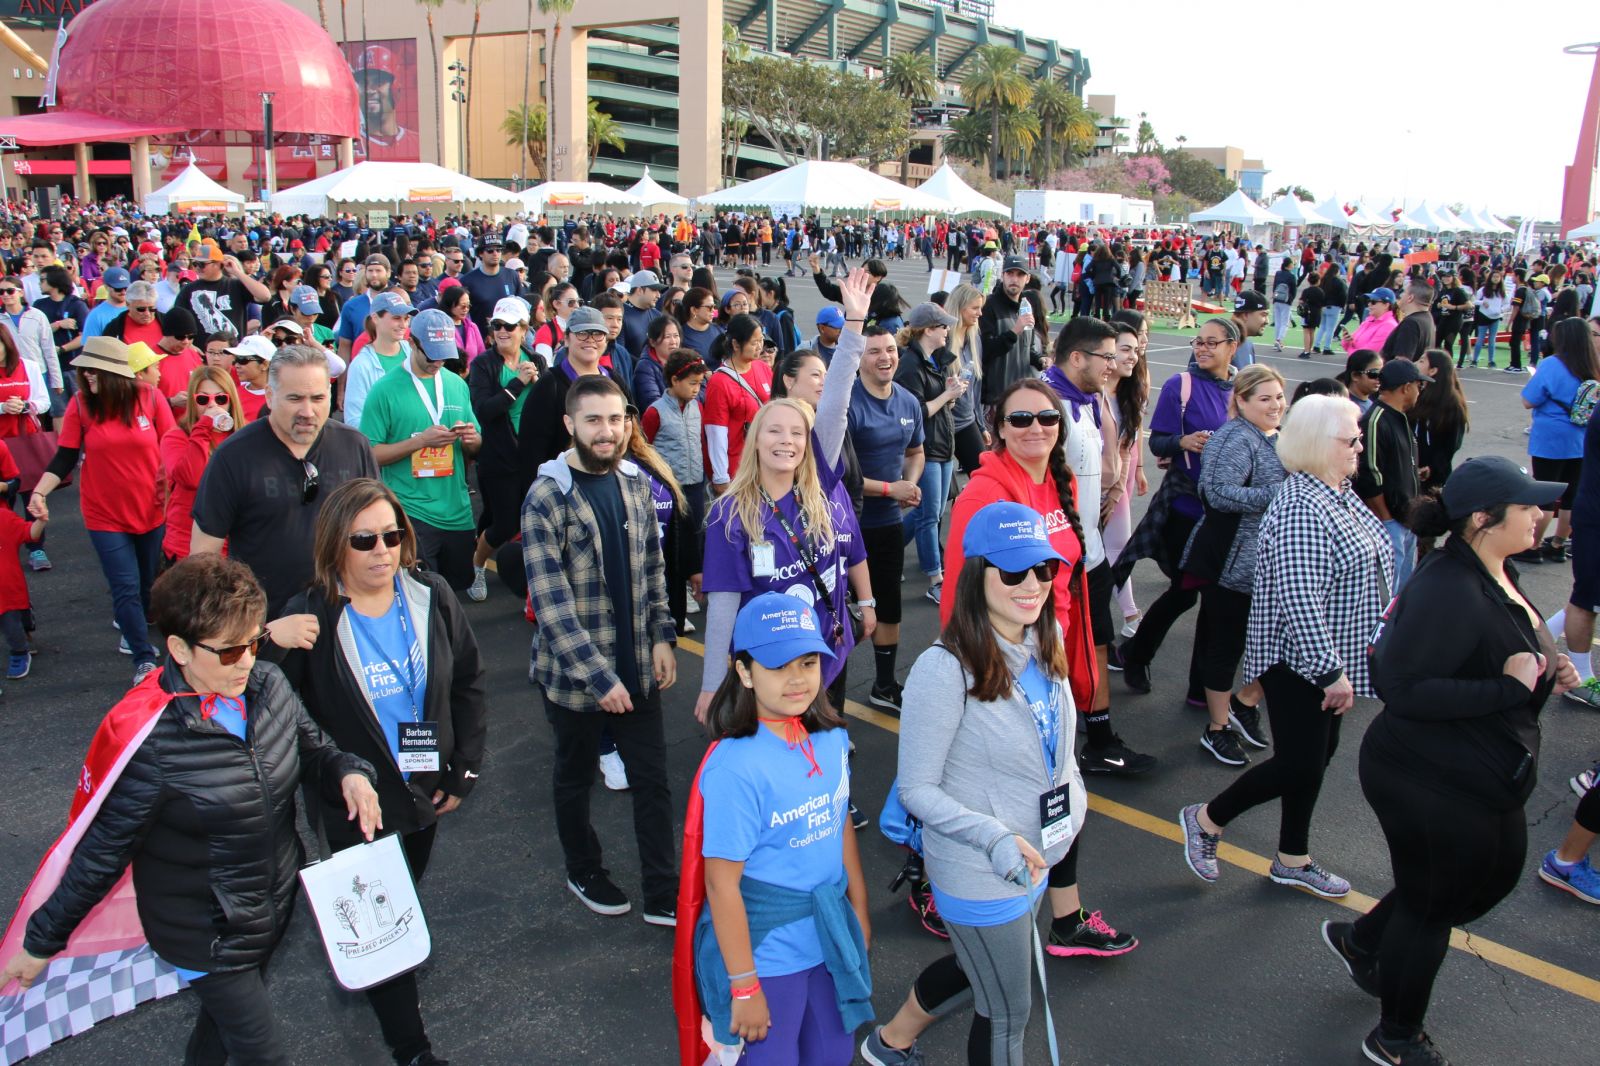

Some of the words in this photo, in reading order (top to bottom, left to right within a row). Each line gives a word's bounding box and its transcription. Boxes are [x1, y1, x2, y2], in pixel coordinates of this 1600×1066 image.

[998, 519, 1032, 530] American
[1017, 526, 1034, 534] First
[761, 609, 797, 621] American
[781, 615, 799, 624] First
[406, 728, 432, 737] Barbara
[402, 737, 437, 746] Hernandez
[1047, 793, 1065, 808] Andrea
[770, 793, 830, 828] American
[1047, 804, 1063, 818] Reyes
[808, 808, 831, 829] First
[789, 832, 814, 848] Credit
[814, 827, 833, 841] Union
[348, 941, 378, 955] PRESSED
[379, 928, 404, 945] JUICERY
